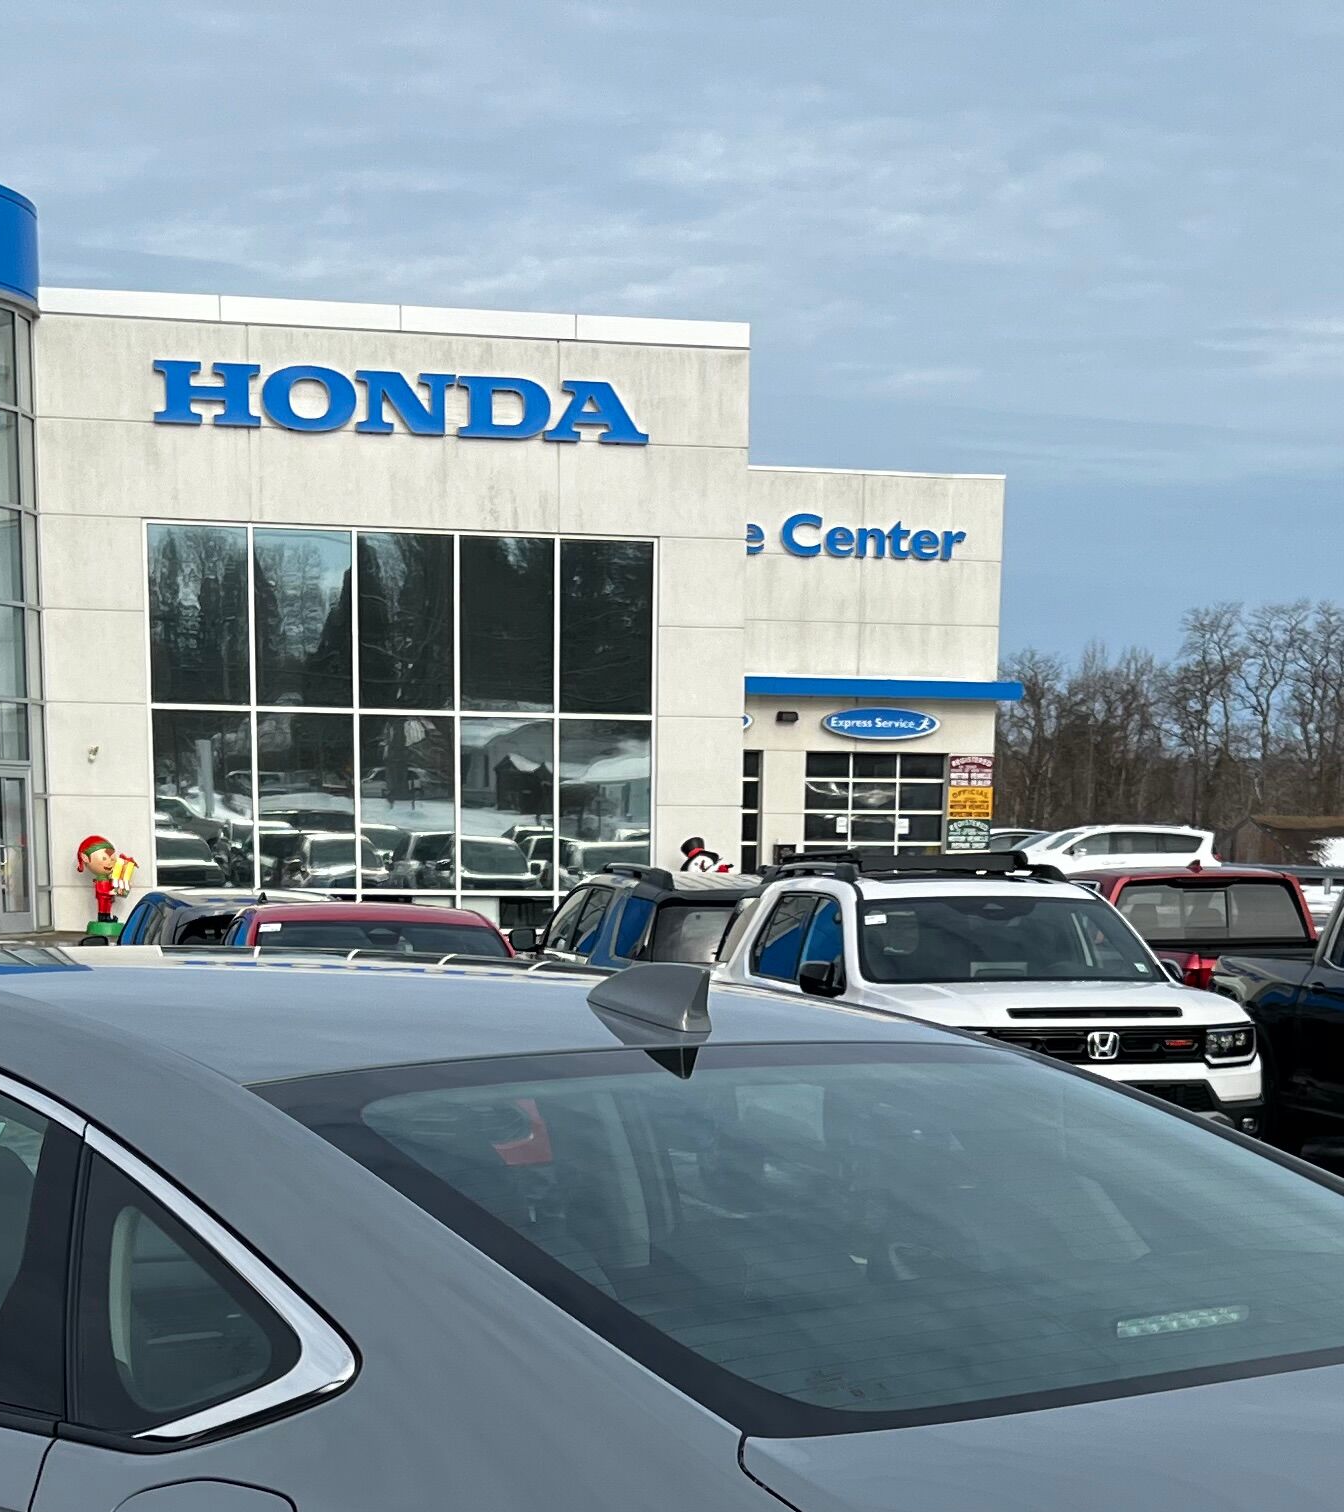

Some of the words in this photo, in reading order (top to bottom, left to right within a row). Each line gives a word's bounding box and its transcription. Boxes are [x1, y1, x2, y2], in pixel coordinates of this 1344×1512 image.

[152, 359, 650, 446] HONDA
[780, 513, 967, 561] Center
[830, 717, 872, 729] Express
[875, 717, 915, 729] Service
[952, 789, 988, 799] OFFICIAL
